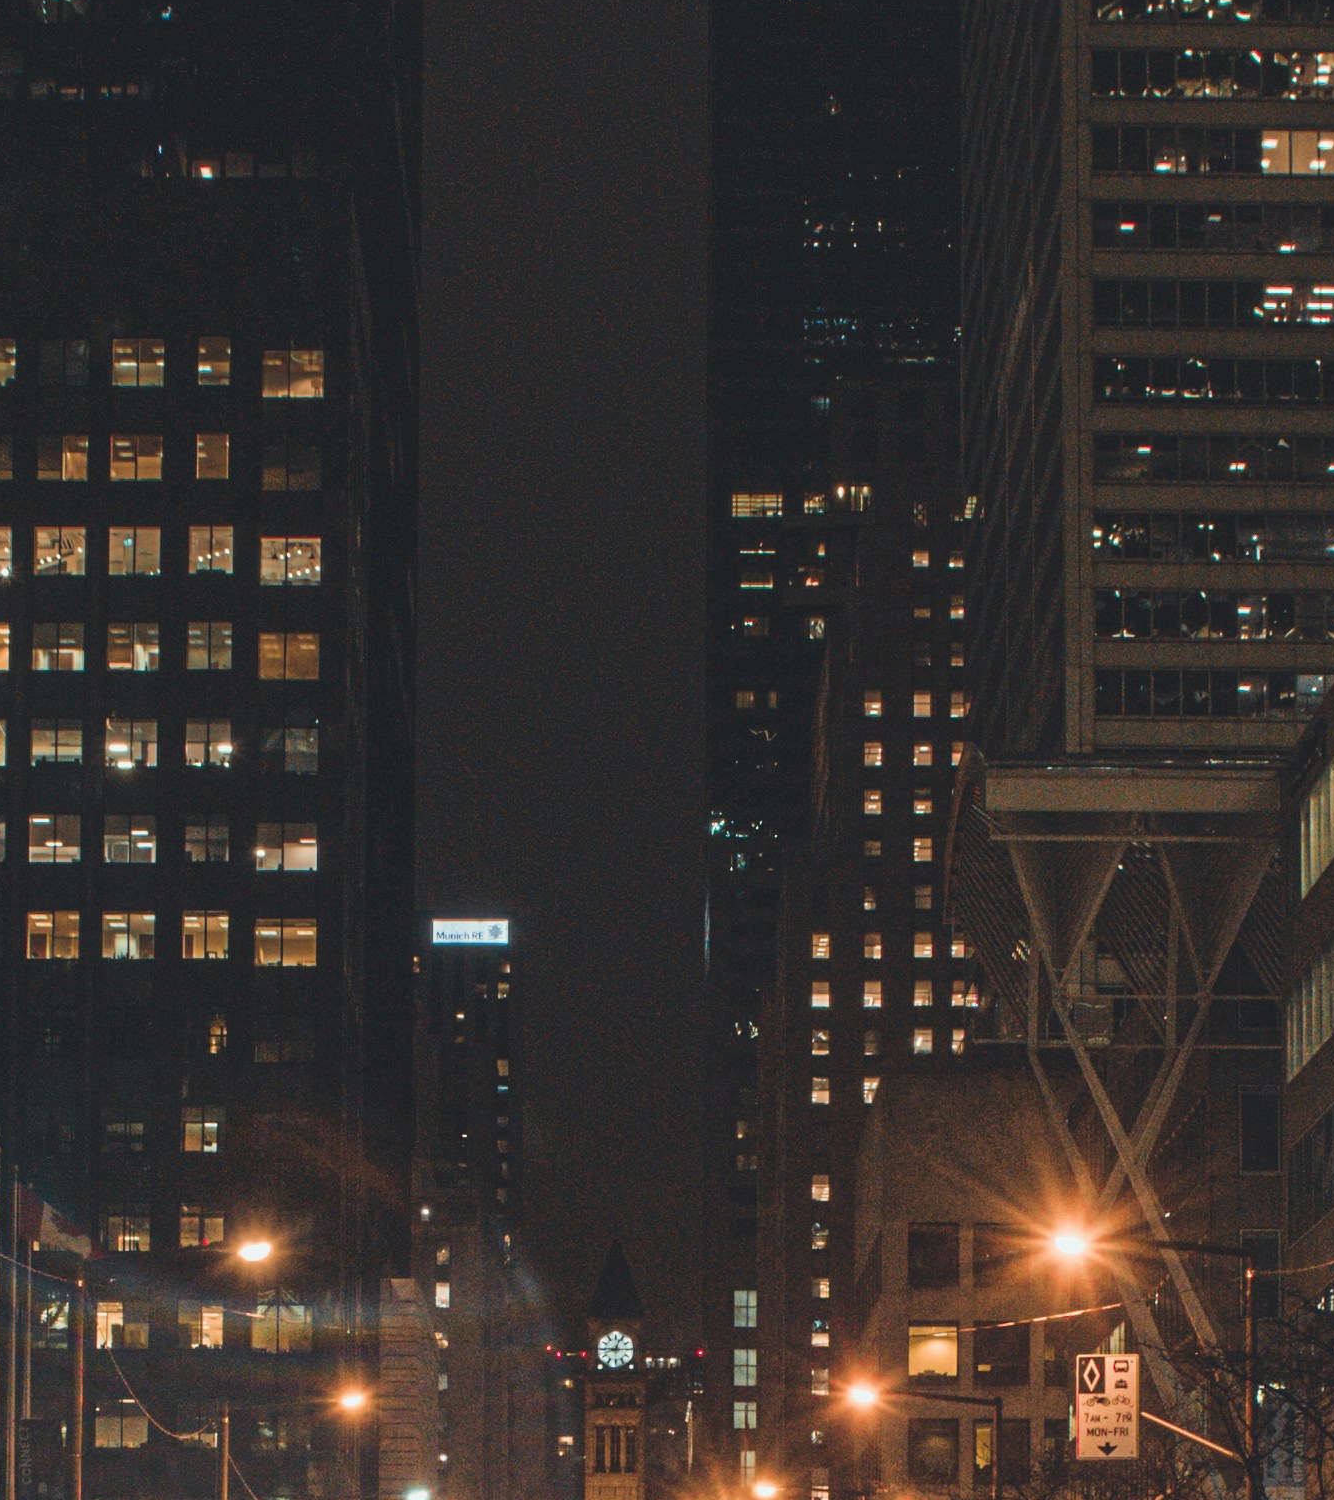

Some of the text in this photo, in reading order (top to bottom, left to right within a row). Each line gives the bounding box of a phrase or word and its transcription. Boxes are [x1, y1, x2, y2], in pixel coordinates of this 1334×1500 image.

[436, 931, 484, 940] Munich RE
[1086, 1427, 1129, 1437] MON-FRI
